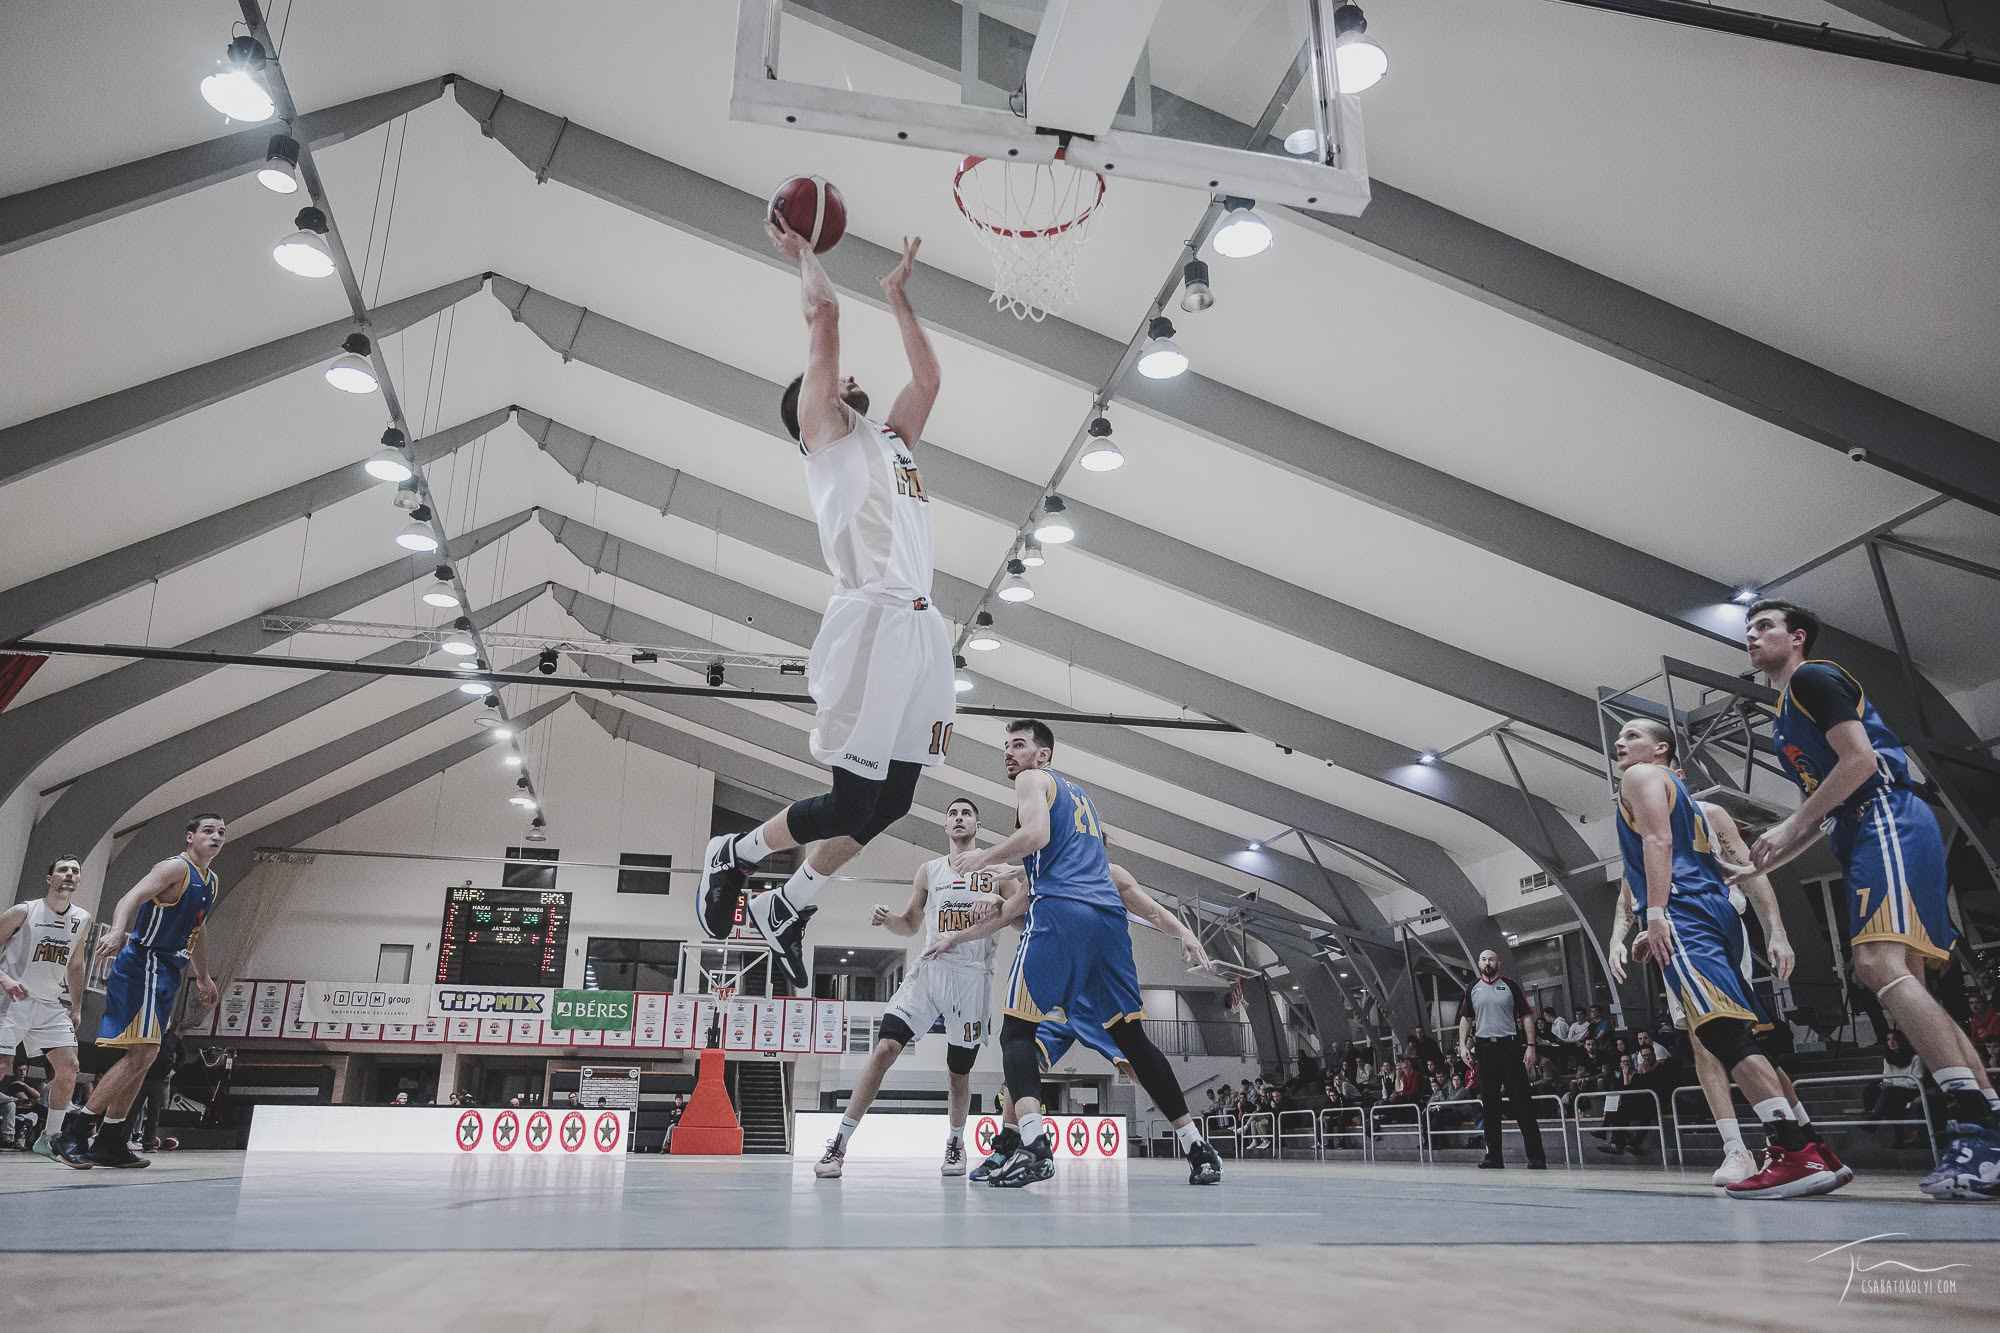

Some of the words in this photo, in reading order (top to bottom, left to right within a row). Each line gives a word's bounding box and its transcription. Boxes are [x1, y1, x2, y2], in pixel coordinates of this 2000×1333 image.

[843, 753, 879, 770] SPALDING
[970, 872, 993, 894] 13
[453, 889, 485, 902] MAFC
[1856, 888, 1871, 918] 7
[71, 917, 80, 934] 7
[938, 909, 977, 933] MAF
[388, 995, 411, 1005] group
[575, 1000, 628, 1018] BÉRES
